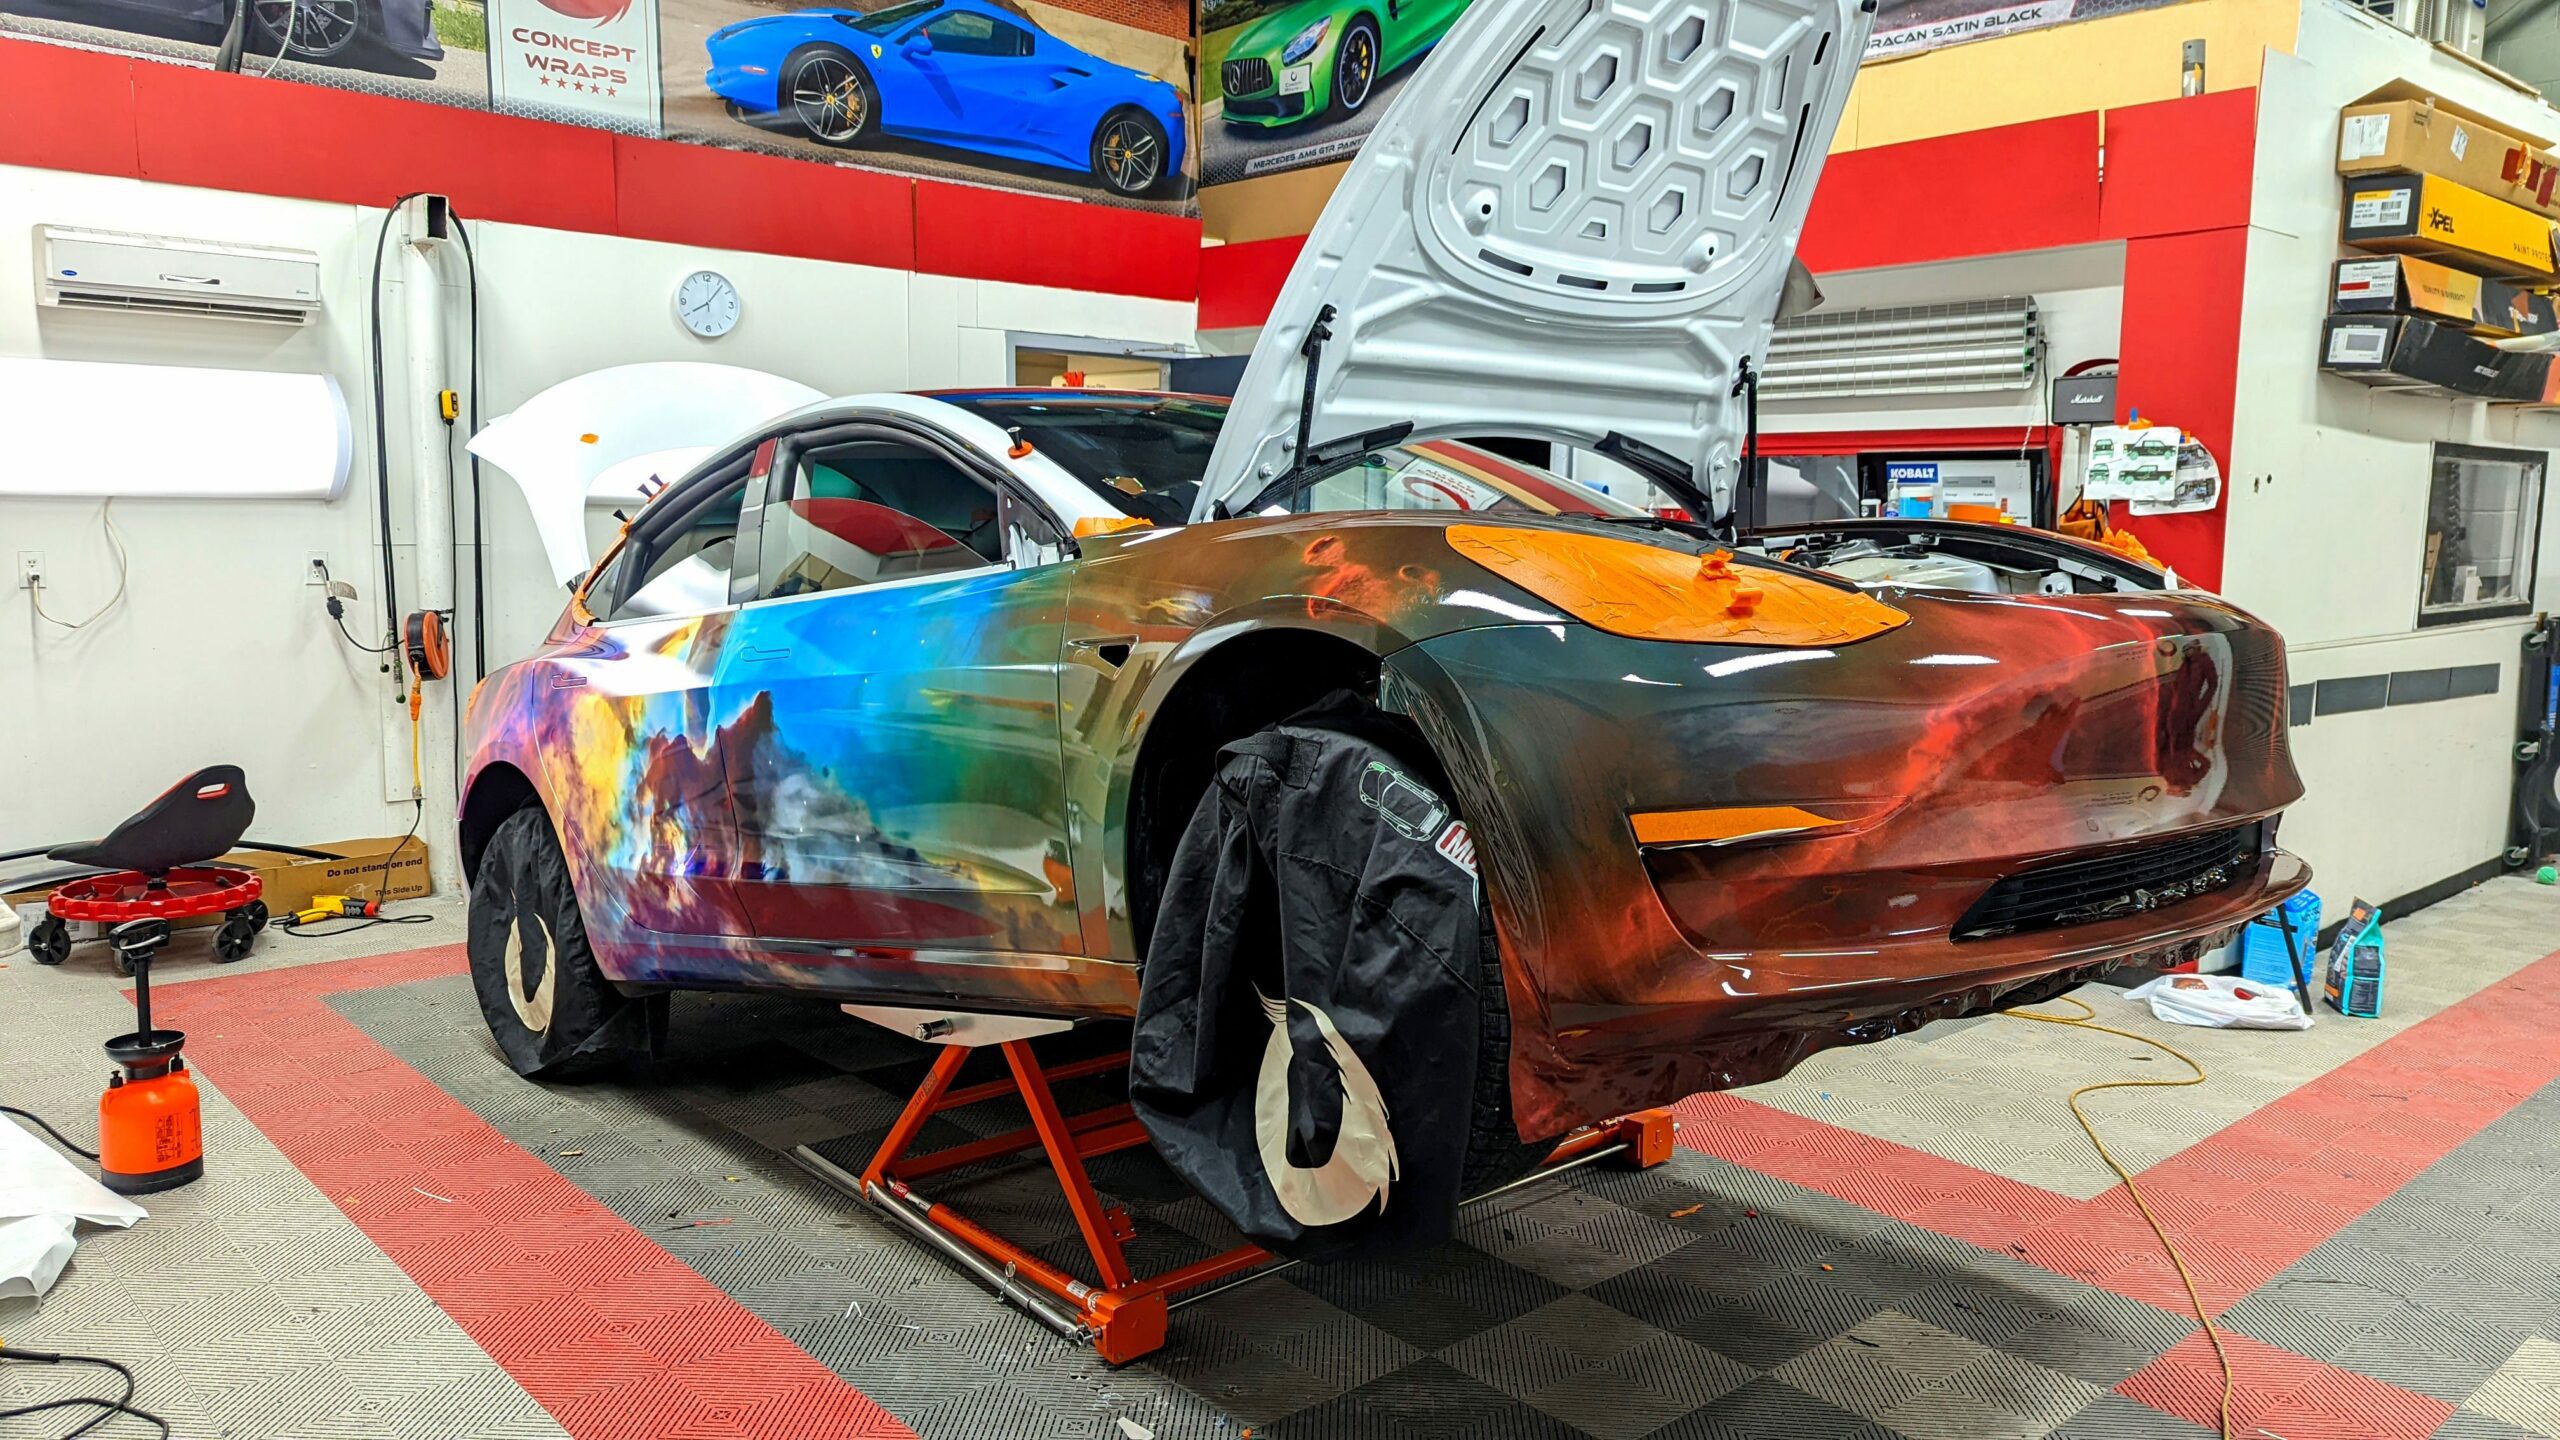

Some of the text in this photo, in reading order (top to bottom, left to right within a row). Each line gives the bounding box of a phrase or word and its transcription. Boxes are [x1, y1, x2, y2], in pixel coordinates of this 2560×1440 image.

[1866, 7, 2043, 49] RACAN SATIN BLACK
[512, 27, 637, 63] CONCEPT
[524, 52, 628, 85] WRAPS
[1253, 153, 1296, 169] MERCEDES
[1319, 144, 1335, 155] GTR
[1337, 138, 1362, 151] PAINT
[2429, 206, 2455, 234] XPEL
[702, 273, 712, 282] 12
[680, 297, 687, 306] 9
[728, 301, 735, 310] 3
[705, 324, 712, 333] 6
[2070, 393, 2105, 404] Marshall
[1890, 467, 1935, 479] KOBALT
[327, 857, 423, 878] Do not stand on end
[393, 886, 410, 895] Side
[411, 884, 422, 894] Up
